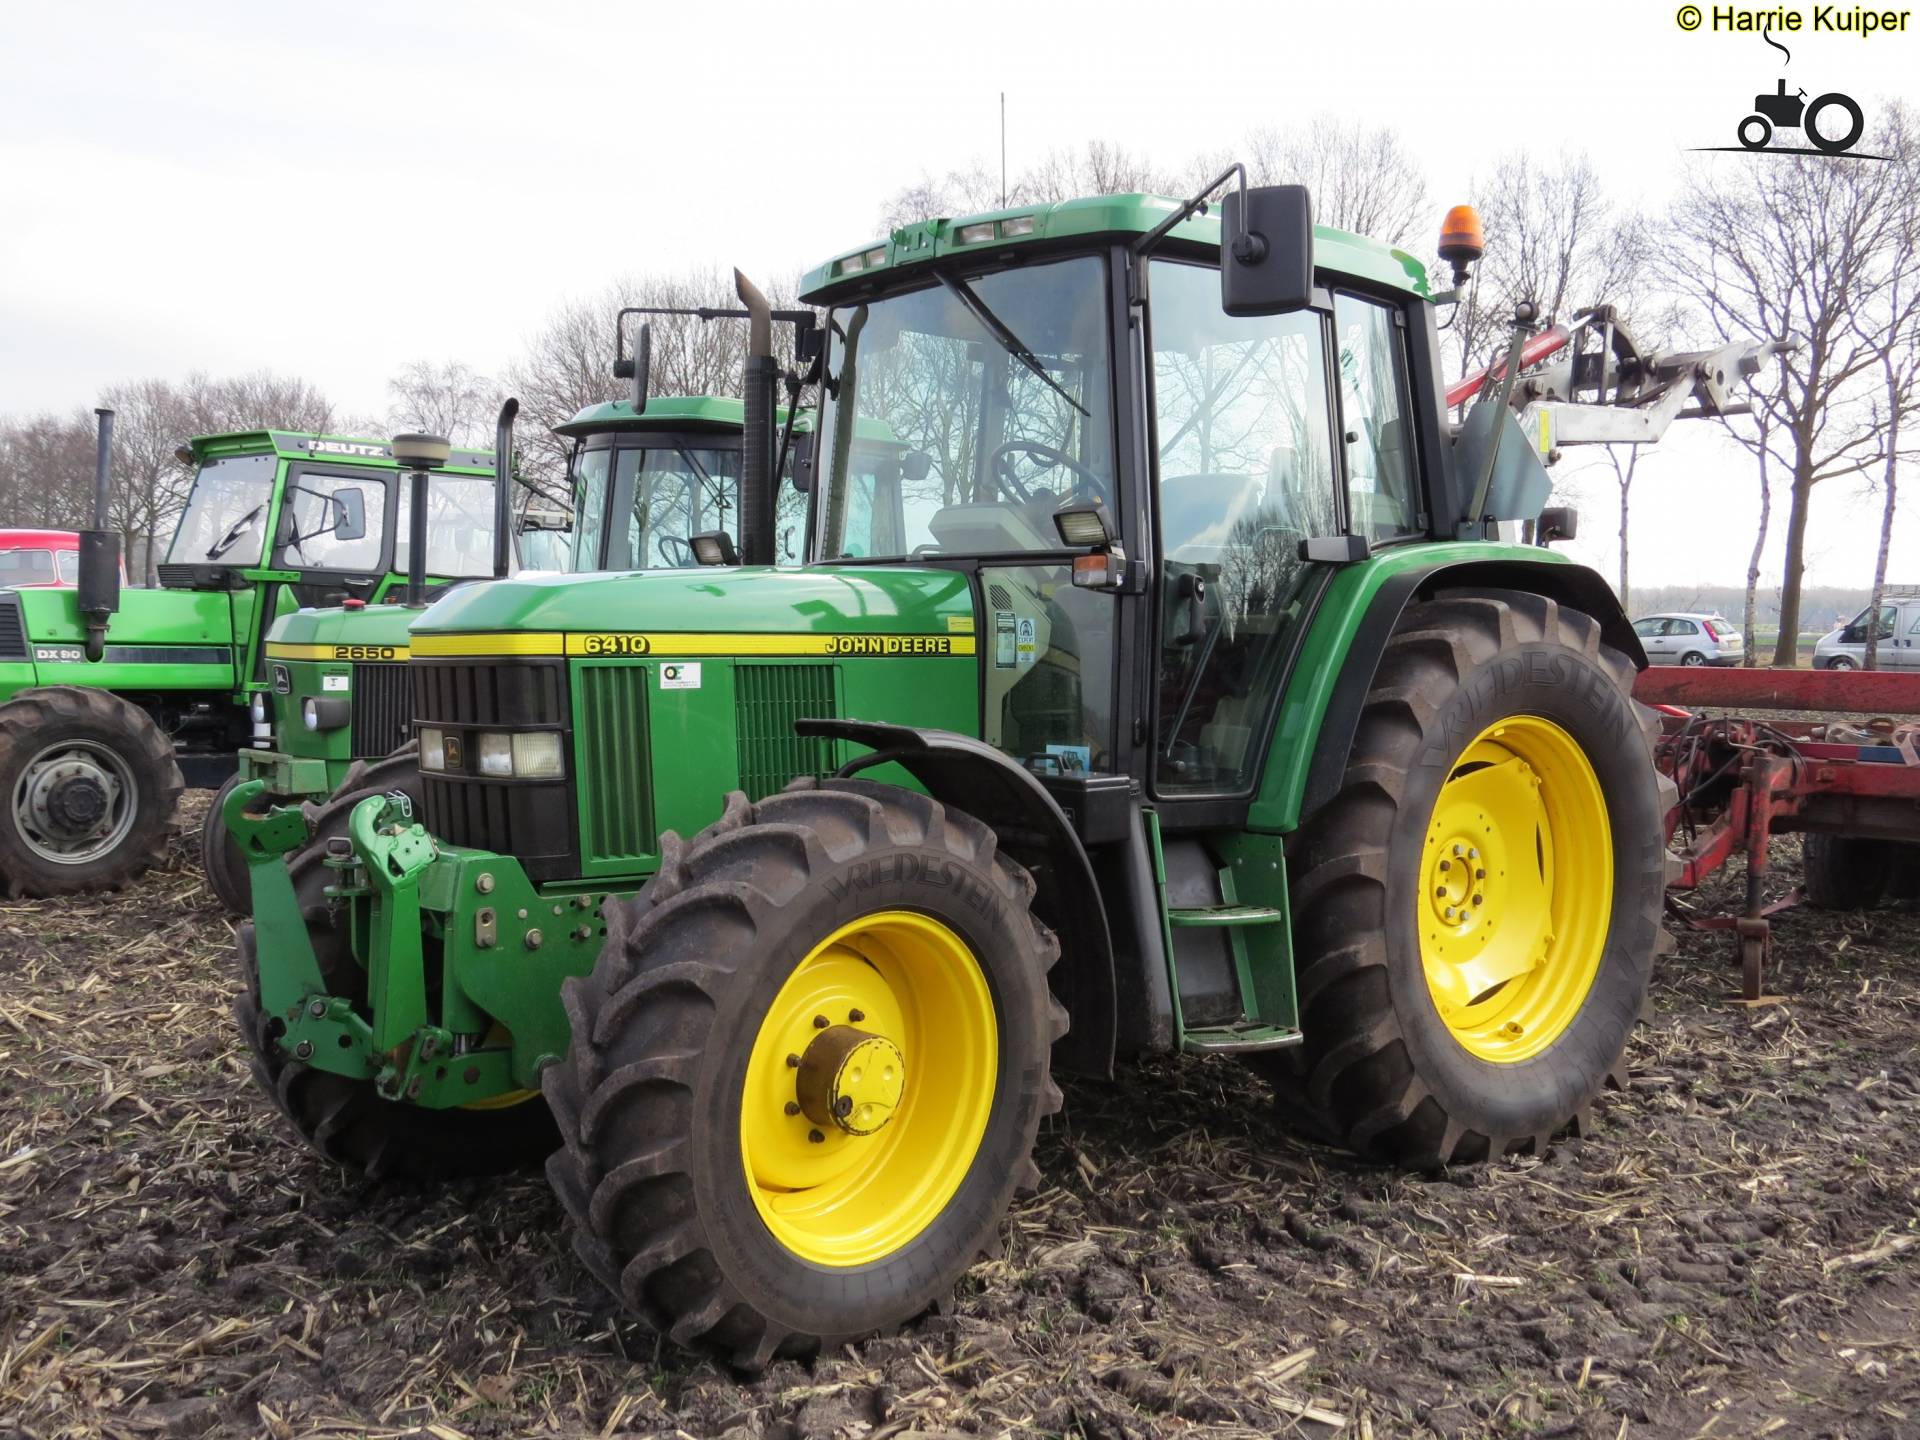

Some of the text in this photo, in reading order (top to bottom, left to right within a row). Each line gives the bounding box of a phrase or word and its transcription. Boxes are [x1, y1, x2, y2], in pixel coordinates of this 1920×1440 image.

[308, 440, 385, 457] DEUTZ
[37, 649, 81, 659] DX 90
[335, 647, 395, 659] 2650
[584, 635, 651, 655] 6410
[825, 636, 952, 655] JOHN DEERE
[822, 852, 1007, 928] VREDESTEIN
